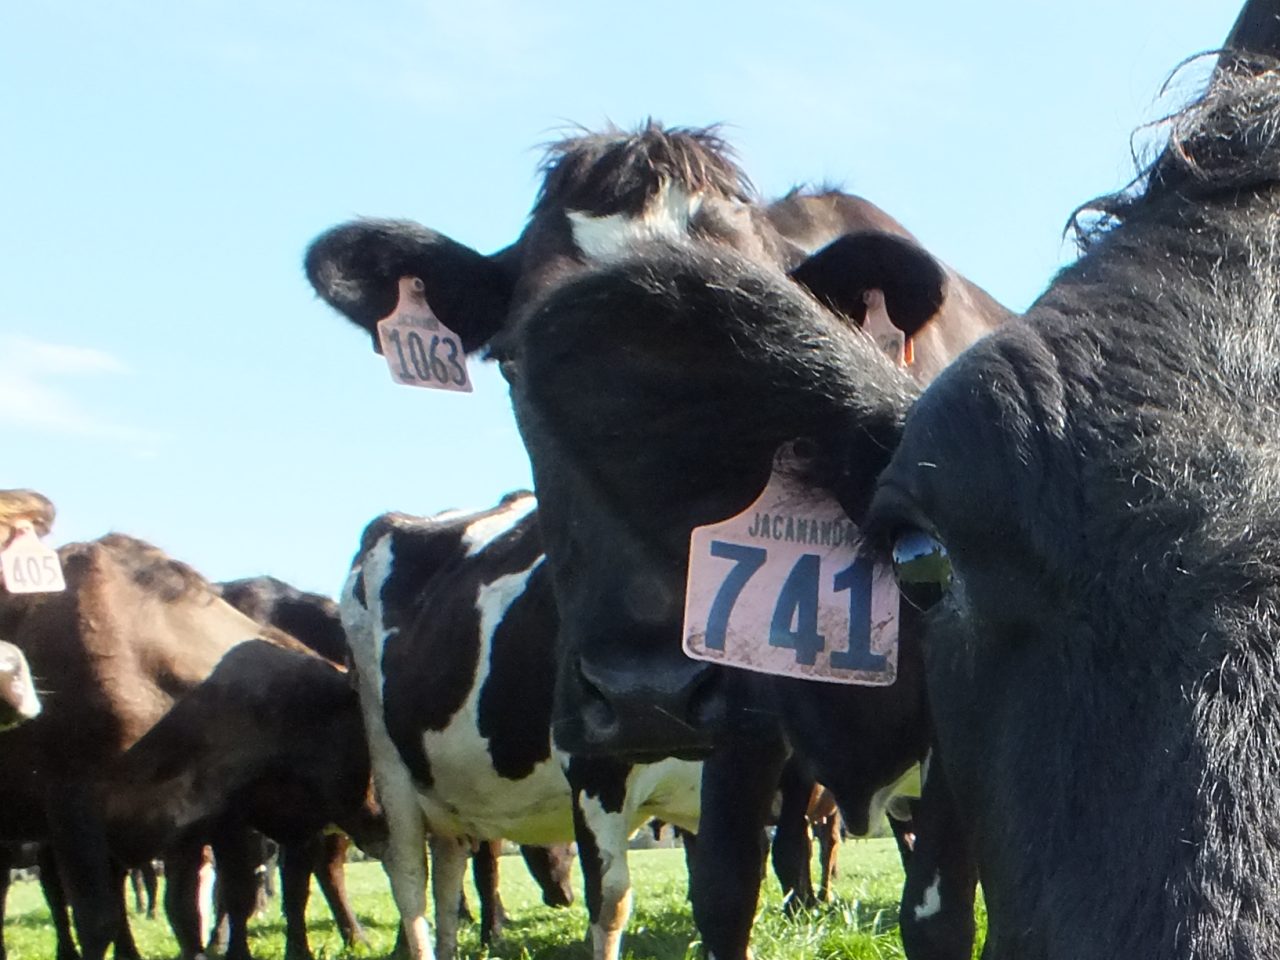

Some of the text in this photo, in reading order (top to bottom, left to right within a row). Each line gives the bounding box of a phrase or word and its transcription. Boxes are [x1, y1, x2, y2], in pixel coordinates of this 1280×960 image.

[389, 329, 466, 386] 1063
[12, 556, 57, 586] 405
[705, 540, 887, 672] 741
